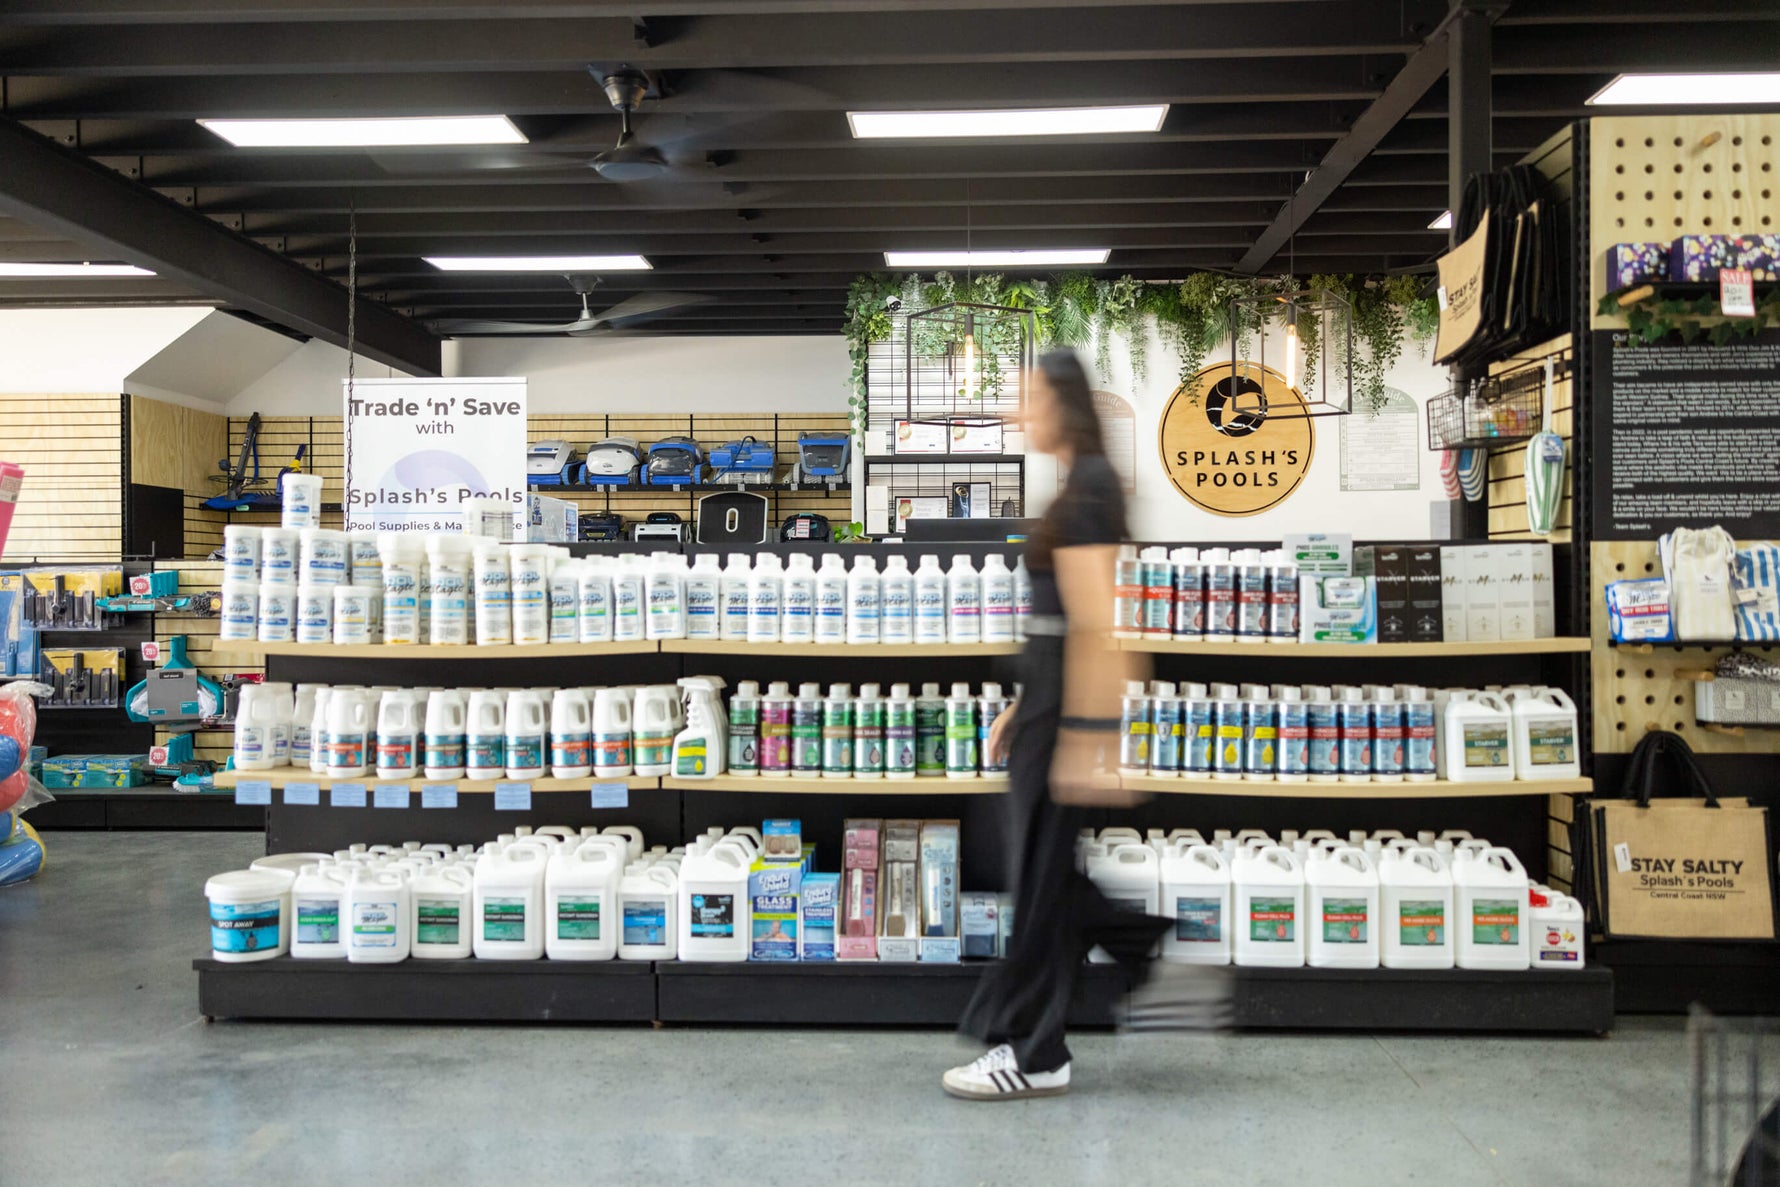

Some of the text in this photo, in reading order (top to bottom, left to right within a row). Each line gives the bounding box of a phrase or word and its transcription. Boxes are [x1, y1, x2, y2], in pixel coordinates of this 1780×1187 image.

[1722, 270, 1750, 284] SALE
[1612, 333, 1627, 342] Our
[350, 398, 419, 416] Trade
[463, 398, 521, 416] Save
[415, 420, 455, 434] with
[1177, 450, 1298, 466] SPLASH’S
[1196, 471, 1279, 487] POOLS
[349, 488, 447, 507] Splash’s
[350, 521, 376, 531] Pool
[379, 521, 430, 533] Supplies
[433, 521, 441, 531] &
[1631, 858, 1743, 875] STAY SALTY
[1640, 874, 1734, 887] Splash's Pools
[757, 896, 792, 904] GLASS
[218, 920, 254, 929] SPOT AWAY
